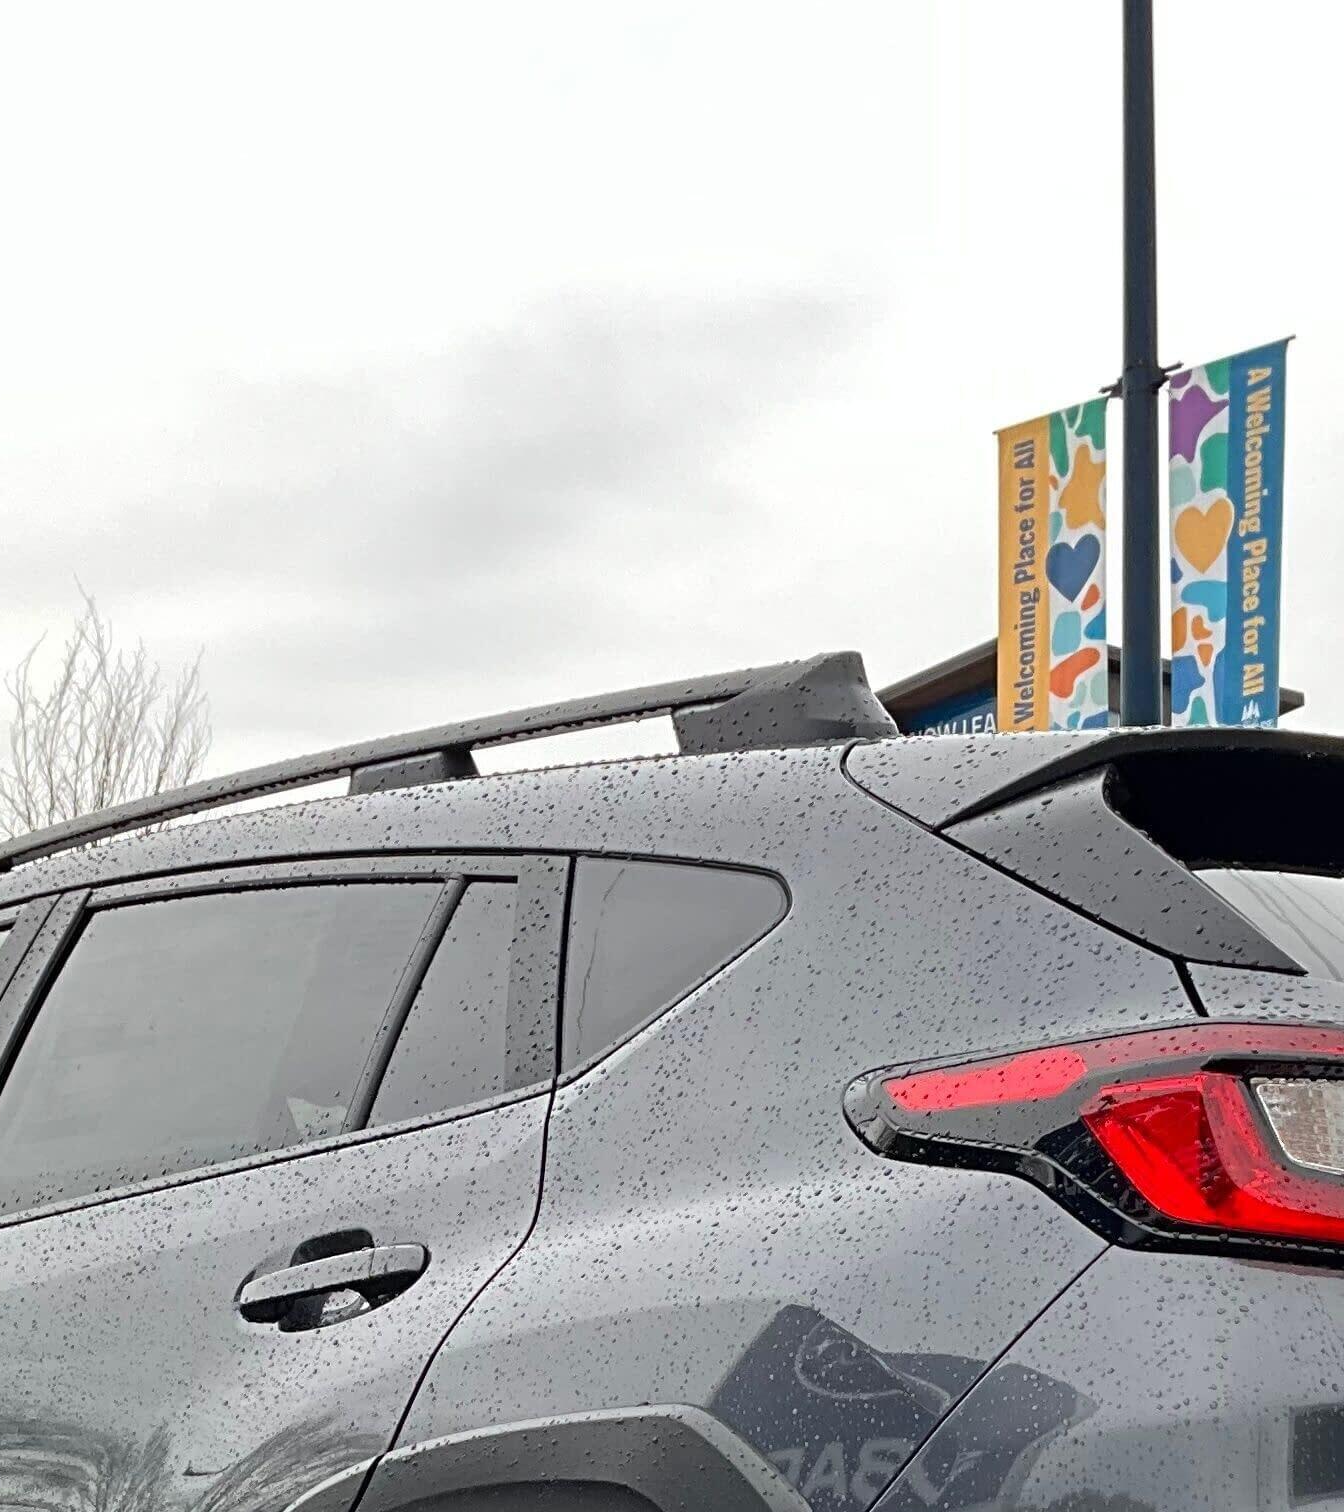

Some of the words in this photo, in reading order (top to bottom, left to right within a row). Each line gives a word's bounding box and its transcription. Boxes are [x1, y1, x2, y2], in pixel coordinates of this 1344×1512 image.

[1247, 367, 1272, 386] A
[1013, 439, 1035, 469] All
[1238, 386, 1272, 536] Welcoming
[1013, 475, 1035, 513] for
[1013, 516, 1036, 584] Place
[1243, 537, 1269, 614] Place
[1013, 586, 1040, 725] Welcoming
[1243, 615, 1266, 656] for
[1242, 661, 1265, 696] All
